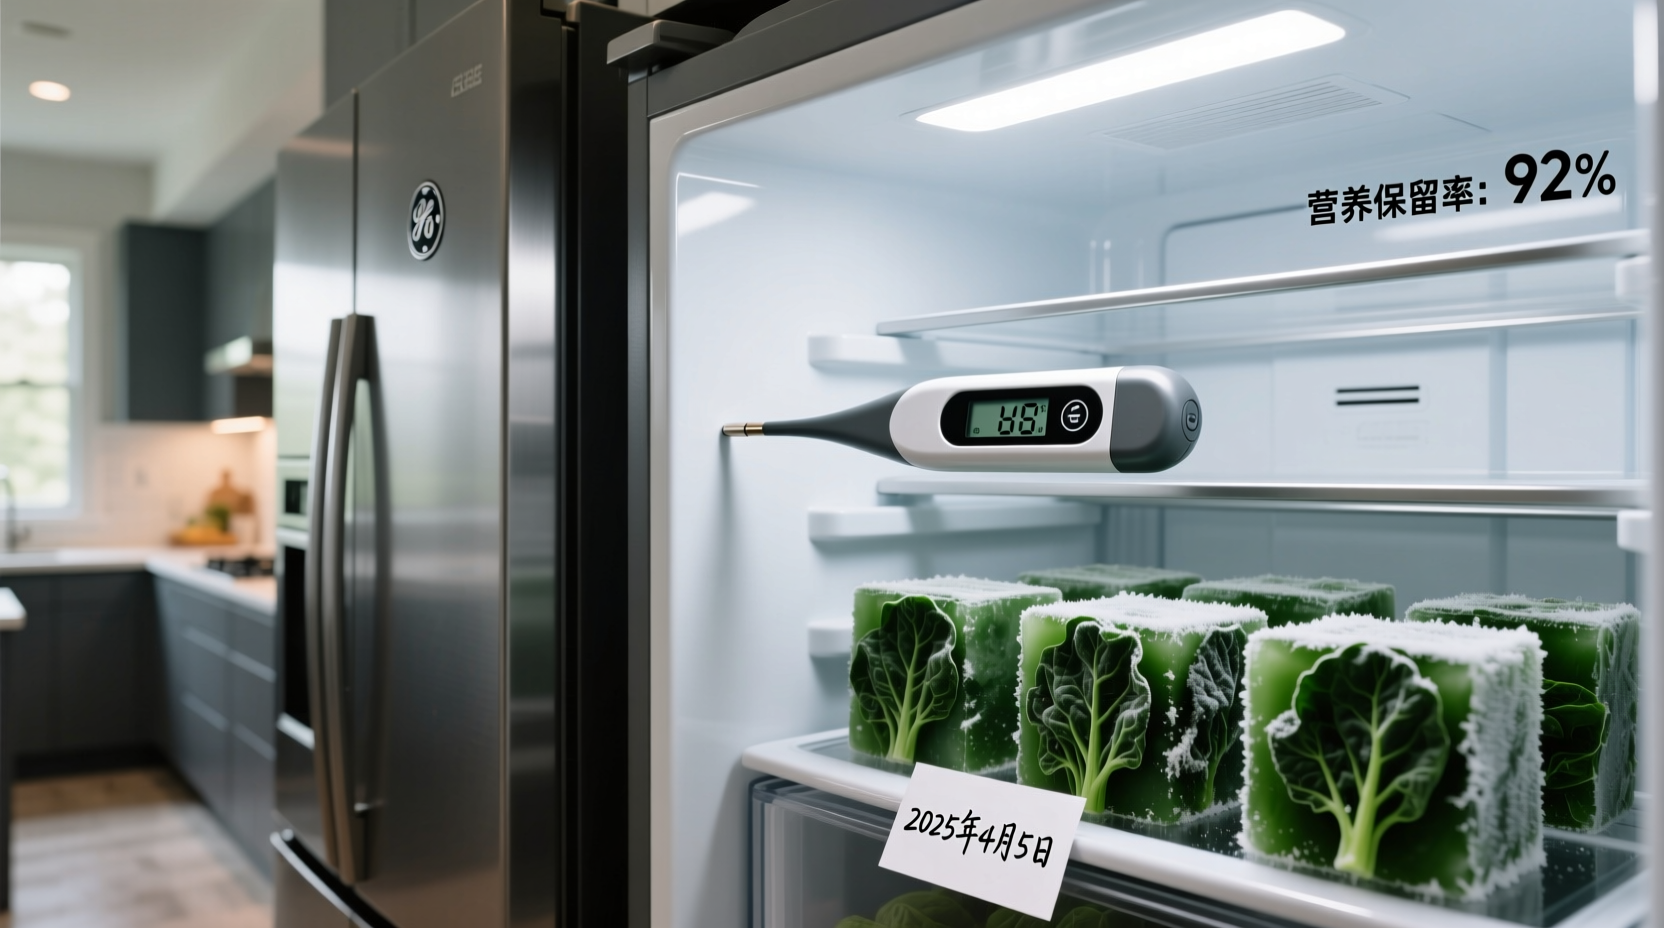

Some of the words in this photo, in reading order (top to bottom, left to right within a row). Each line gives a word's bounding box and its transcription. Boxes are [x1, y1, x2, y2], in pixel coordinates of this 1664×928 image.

[1308, 175, 1487, 226] 营养保留率:
[1505, 149, 1616, 204] 92%
[903, 807, 1053, 868] 2025年4月5日
